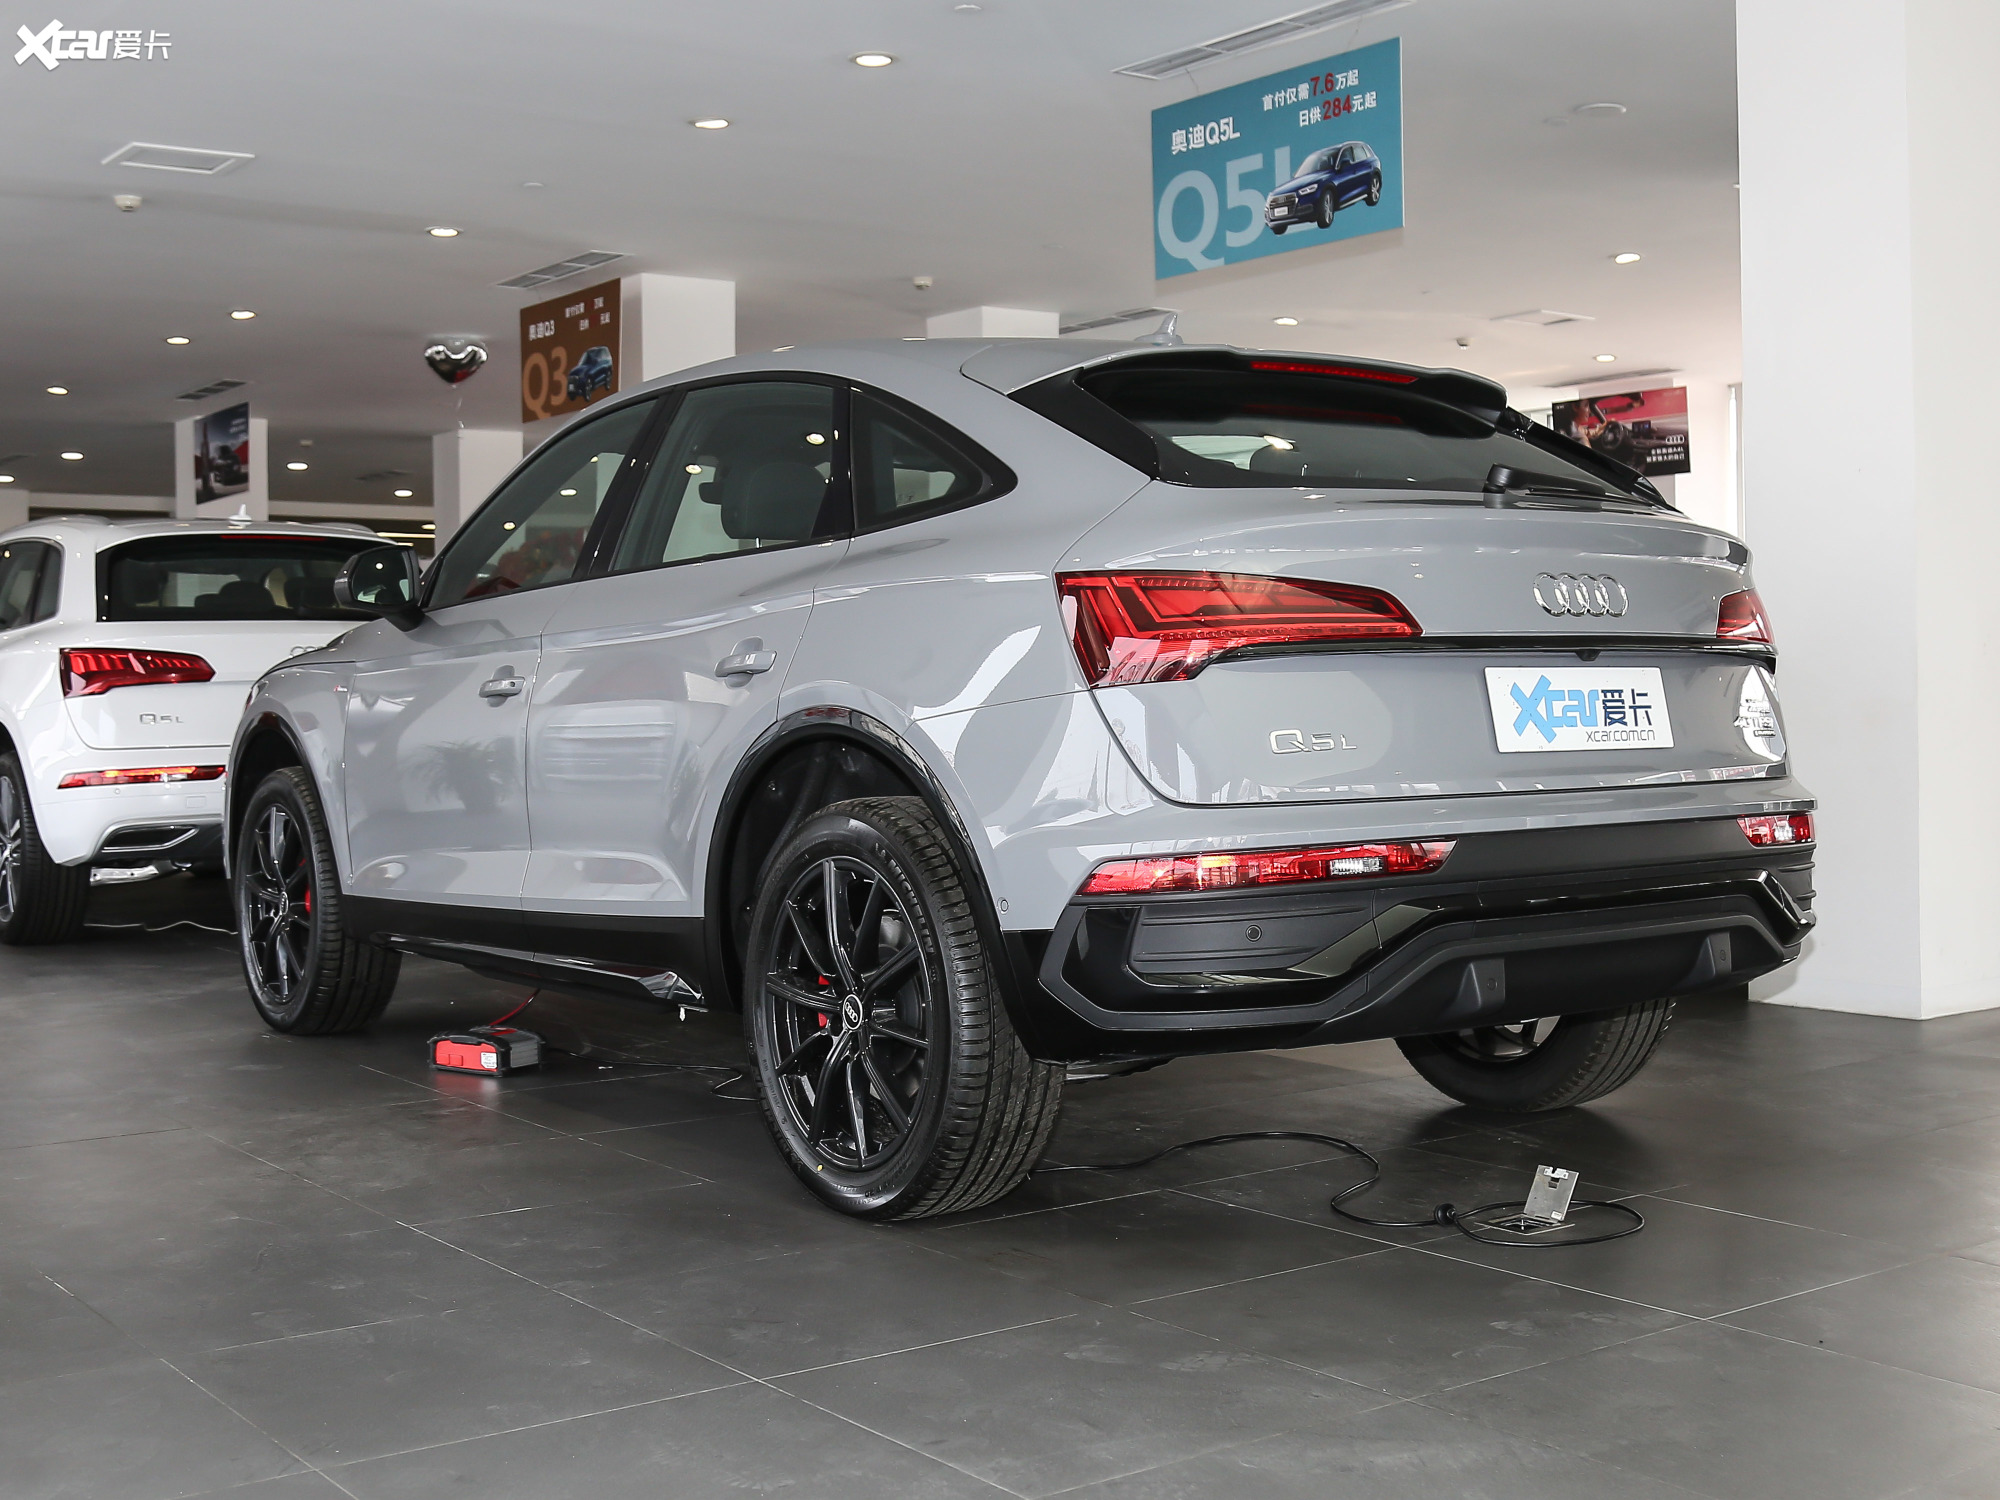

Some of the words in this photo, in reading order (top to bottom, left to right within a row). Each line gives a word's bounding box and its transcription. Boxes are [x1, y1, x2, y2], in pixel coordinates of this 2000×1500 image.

[1171, 117, 1241, 155] 奥迪Q5L
[522, 346, 568, 419] Q3
[1269, 728, 1358, 754] Q5L
